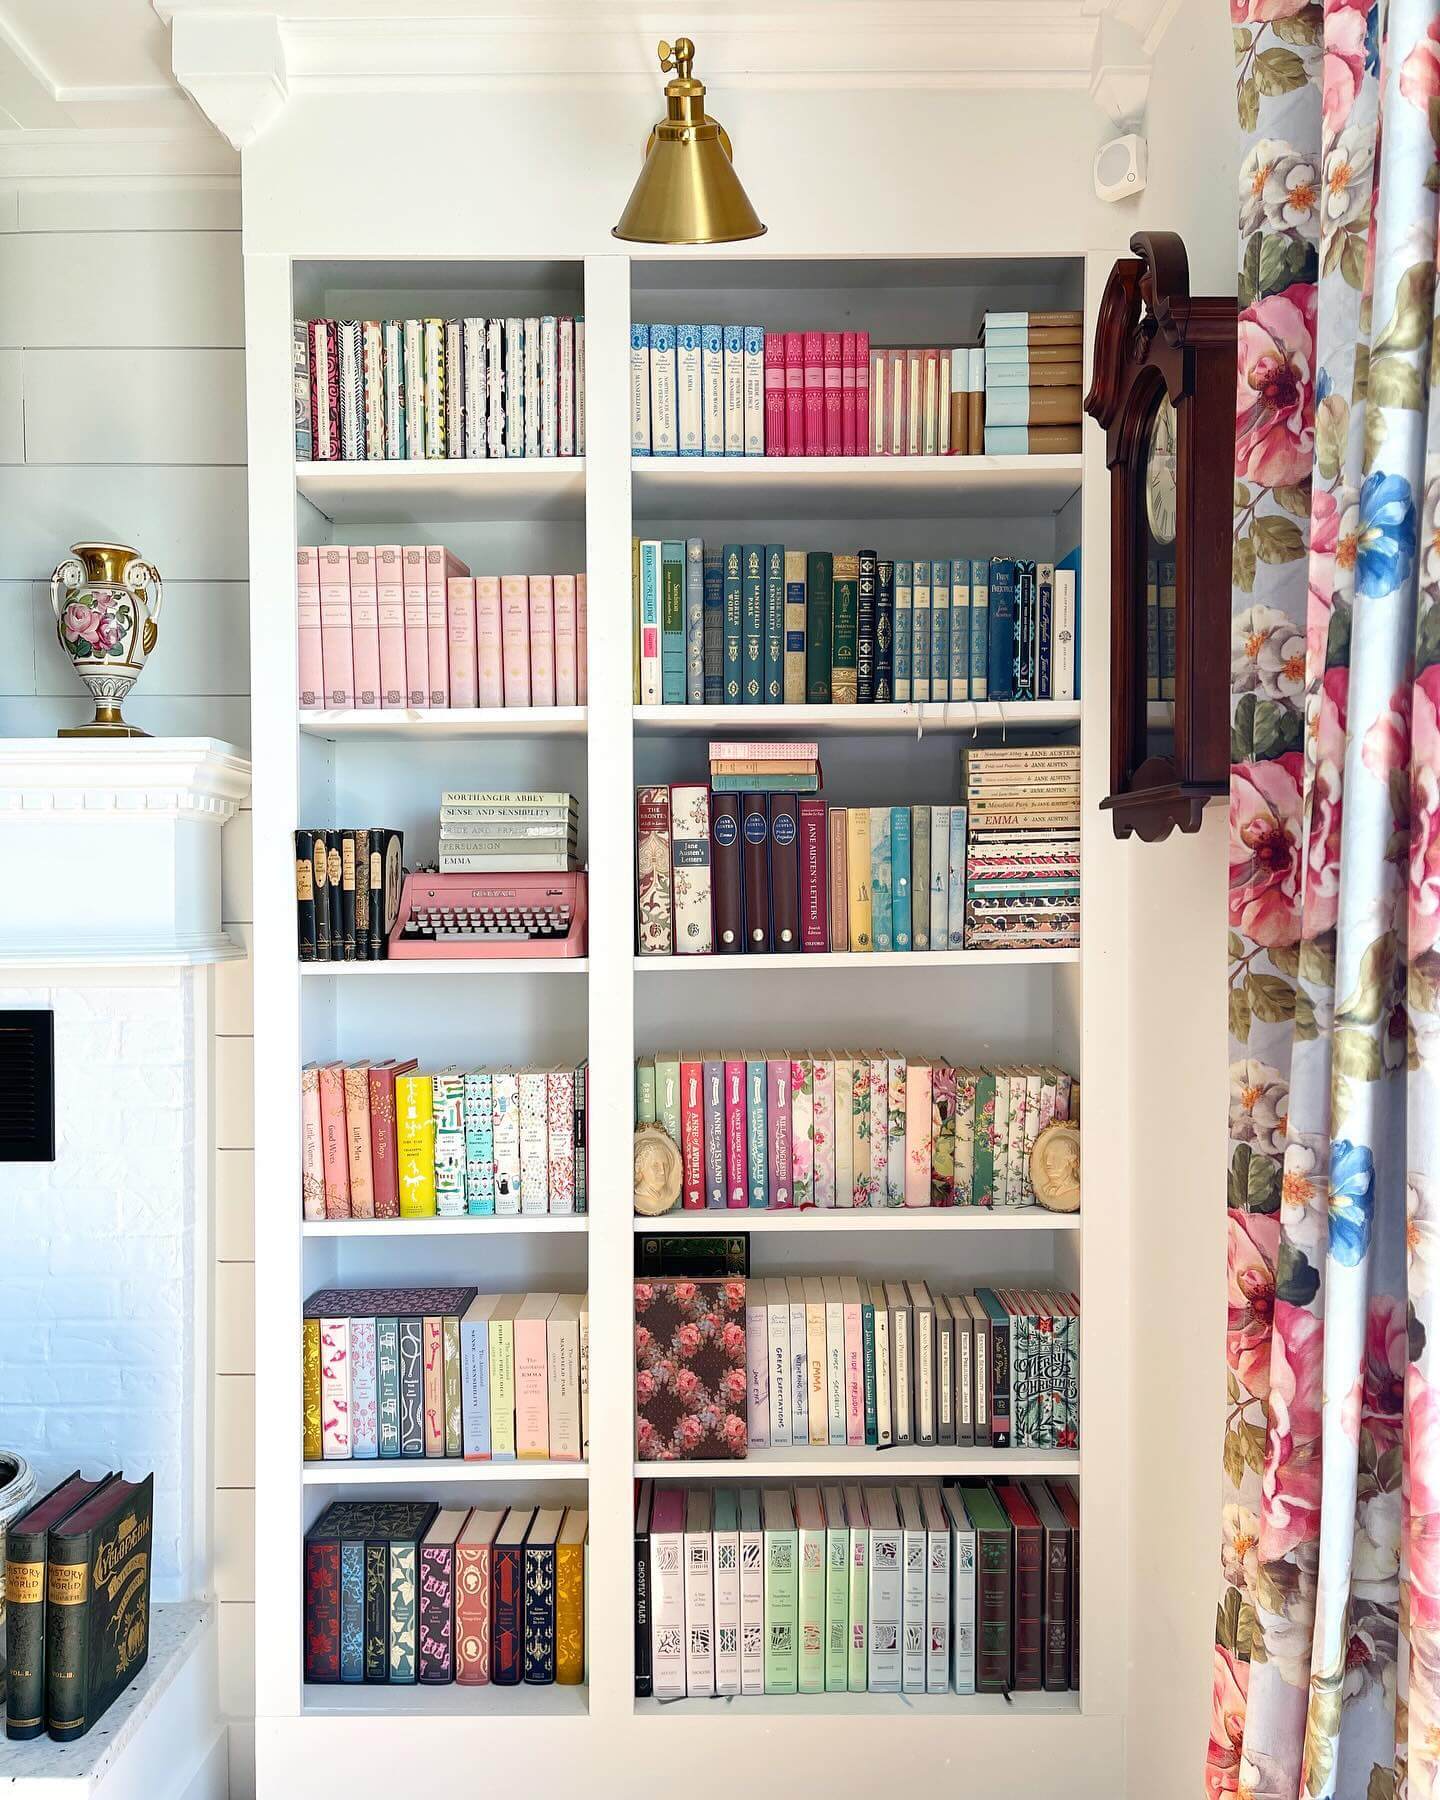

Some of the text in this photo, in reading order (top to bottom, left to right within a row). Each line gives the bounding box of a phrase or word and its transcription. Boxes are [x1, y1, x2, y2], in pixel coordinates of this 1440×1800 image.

[447, 793, 510, 802] NORTHANGER
[497, 808, 551, 816] SENSIBILITY
[984, 816, 1019, 825] EMMA
[443, 842, 501, 850] PERSUASION
[807, 823, 817, 843] JANE
[444, 857, 472, 865] EMMA
[809, 844, 817, 883] AUSTEN'S
[691, 1112, 699, 1137] ANNE
[306, 1123, 316, 1168] Little Women
[329, 1143, 337, 1165] Wives
[353, 1126, 362, 1161] Little Men
[377, 1128, 387, 1159] Jo's Boys
[865, 1329, 873, 1347] Jane
[752, 1369, 760, 1385] JANE
[795, 1354, 803, 1389] WUTHERING
[812, 1360, 822, 1393] EMMA
[1014, 1353, 1071, 1380] MERRY
[776, 1377, 784, 1429] EXPECTATIONS
[865, 1375, 874, 1405] Treasury
[637, 1560, 646, 1624] GHOSTLY TALES
